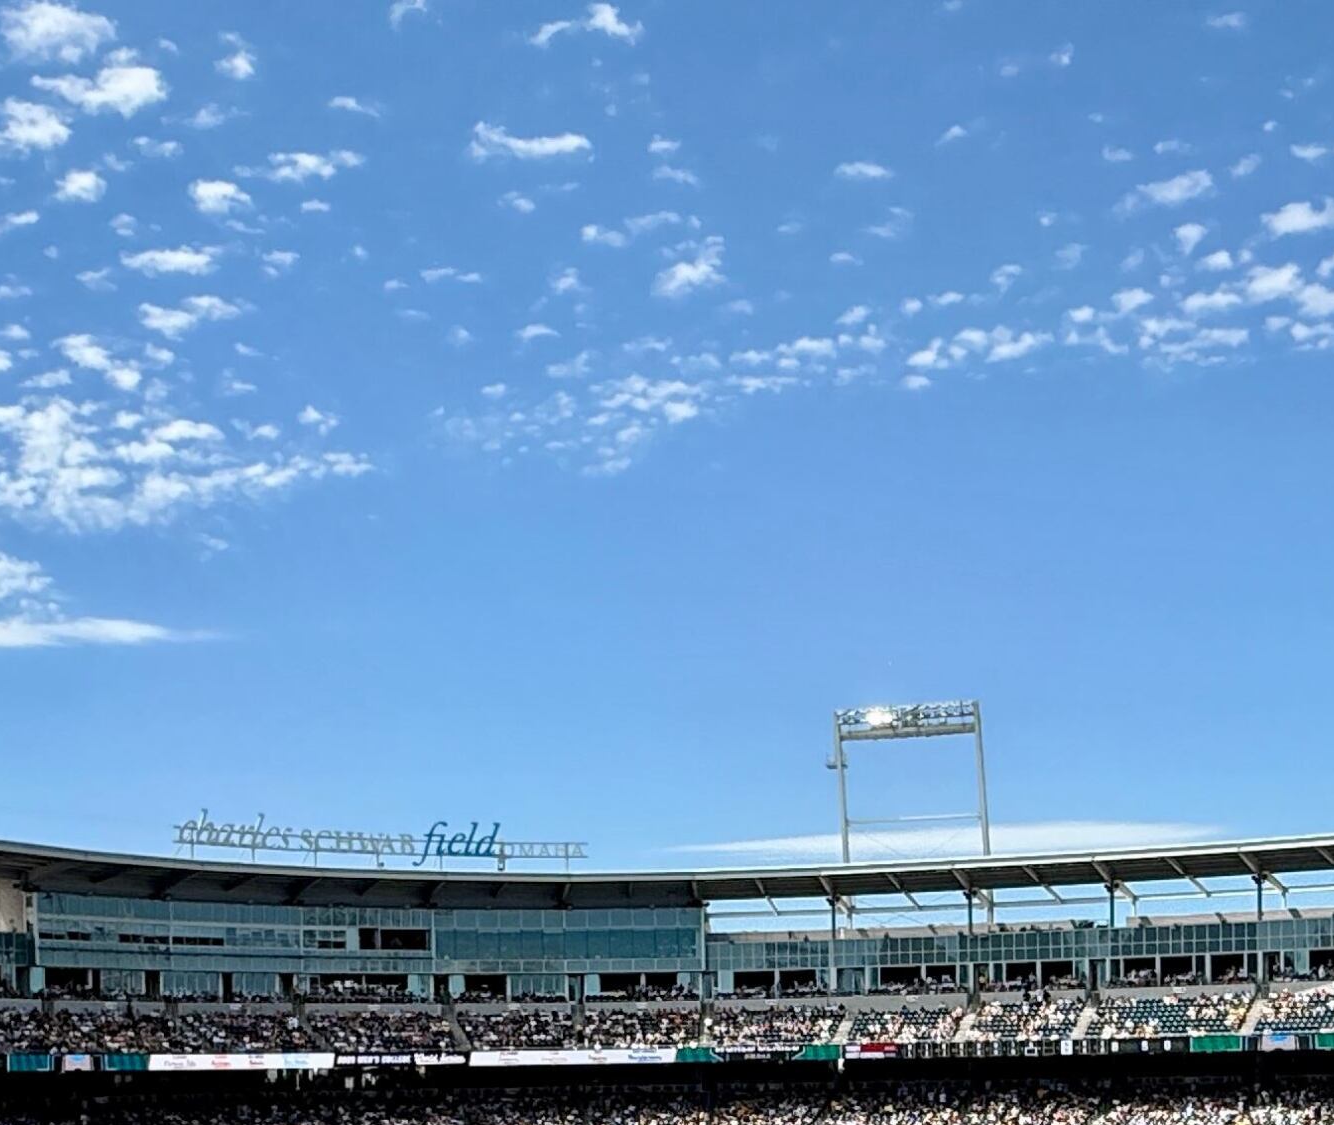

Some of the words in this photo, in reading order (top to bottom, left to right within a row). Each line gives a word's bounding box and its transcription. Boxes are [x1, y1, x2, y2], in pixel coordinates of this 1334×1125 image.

[179, 808, 292, 849] charles
[300, 829, 415, 856] SCHWAB
[412, 821, 501, 867] field
[501, 842, 585, 858] OMAHA
